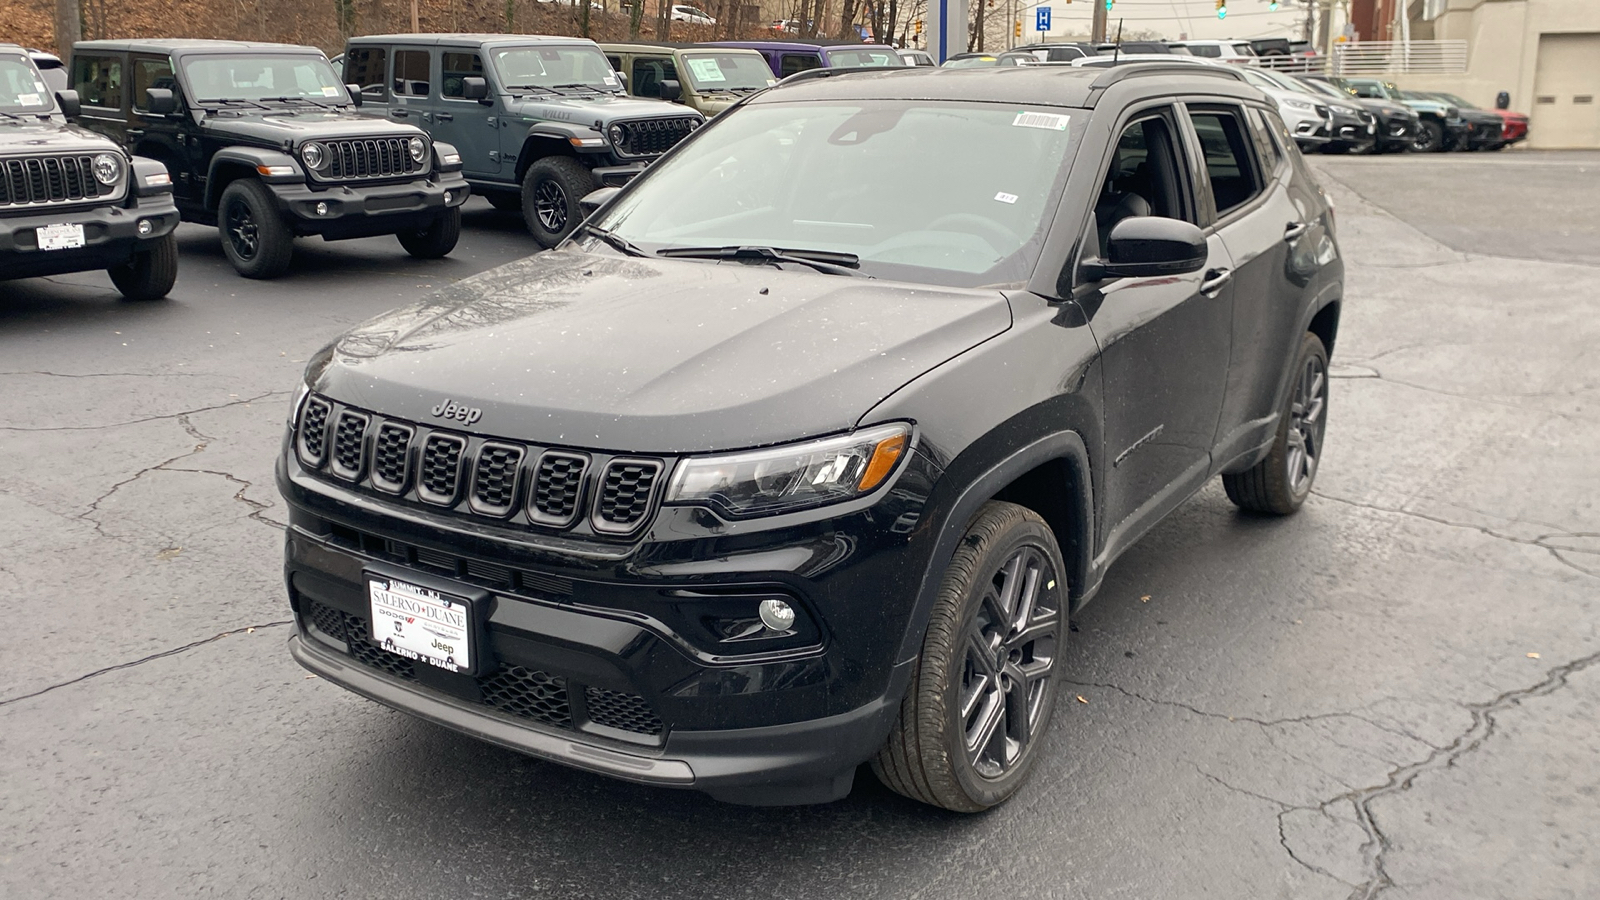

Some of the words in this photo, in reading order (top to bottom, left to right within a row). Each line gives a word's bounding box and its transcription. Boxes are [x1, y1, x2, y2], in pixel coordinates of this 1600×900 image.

[1039, 12, 1048, 24] H
[542, 109, 572, 120] WILLYS
[431, 398, 482, 426] Jeep
[428, 590, 440, 600] NJ
[373, 590, 421, 614] SALERNO
[426, 605, 465, 628] DUANE
[431, 638, 454, 655] Jeep
[381, 642, 418, 660] SALERNO
[430, 657, 458, 672] DUANE
